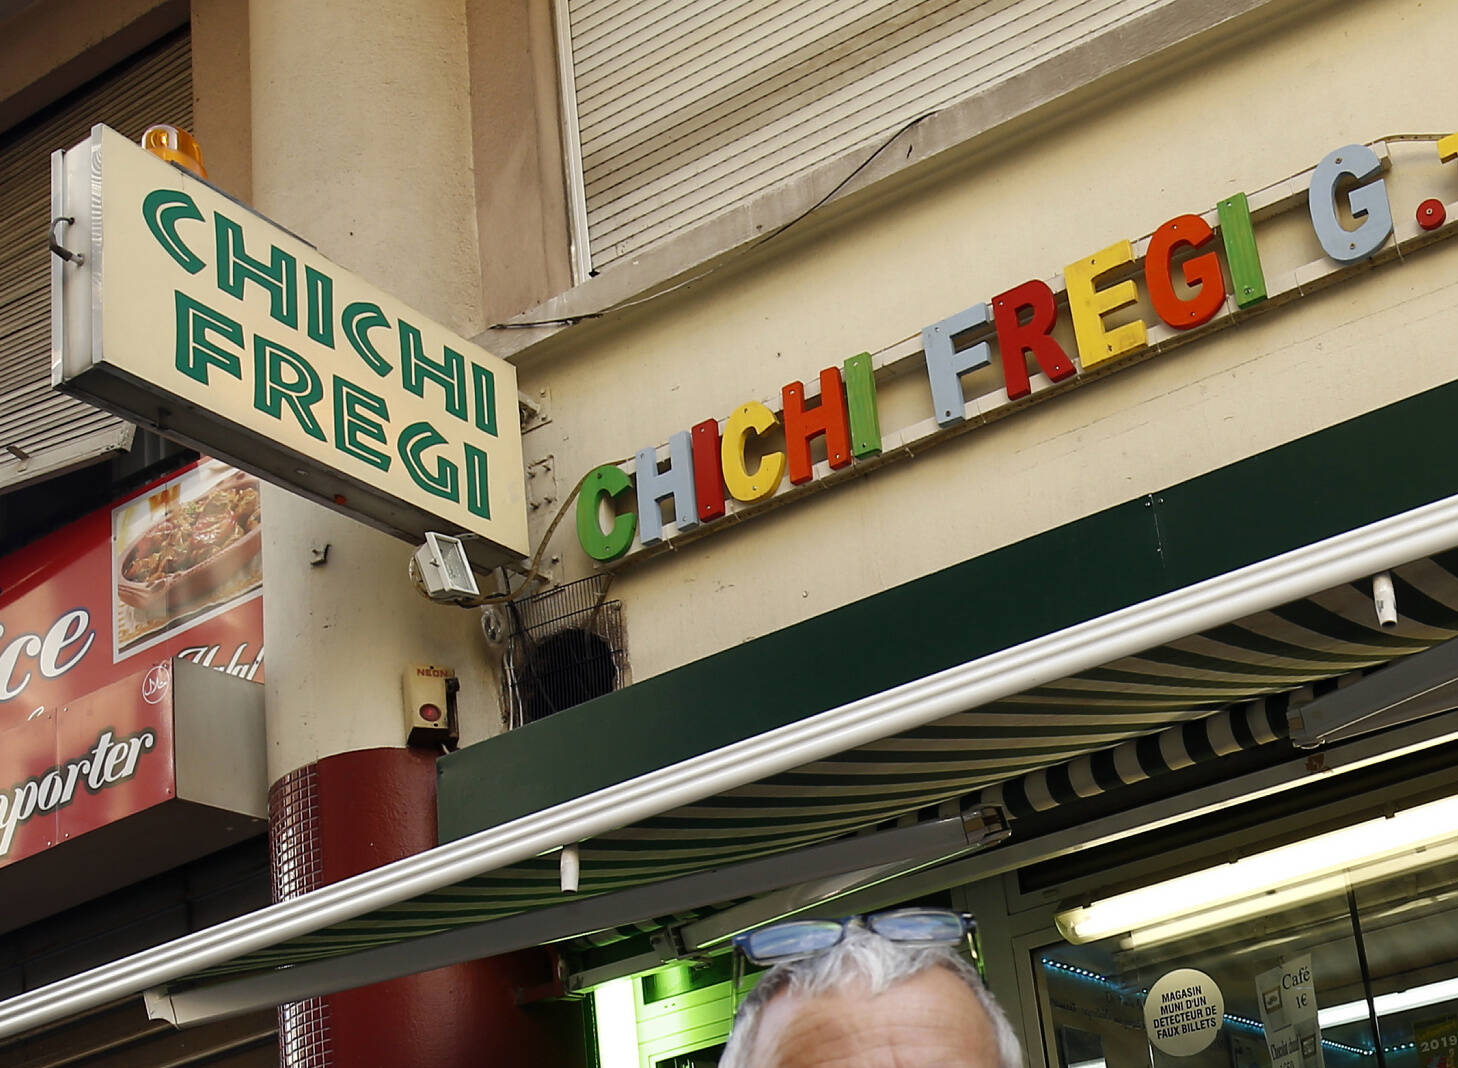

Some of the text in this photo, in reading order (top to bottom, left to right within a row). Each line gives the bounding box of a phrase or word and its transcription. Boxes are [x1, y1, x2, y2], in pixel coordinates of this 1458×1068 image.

[142, 189, 498, 437] CHICHI
[576, 351, 883, 563] CHICHI
[922, 196, 1267, 428] FREGI
[174, 289, 491, 520] FREGI
[0, 610, 96, 700] ce
[1282, 966, 1311, 990] Café
[1160, 996, 1207, 1016] MUNI D'UN
[1161, 985, 1202, 1003] MAGASIN
[1296, 993, 1308, 1009] 1€
[1153, 1009, 1203, 1029] DETECTEUR
[1205, 1005, 1217, 1016] DE
[1157, 1018, 1217, 1039] FAUX BILLETS
[1420, 1035, 1457, 1053] 2019
